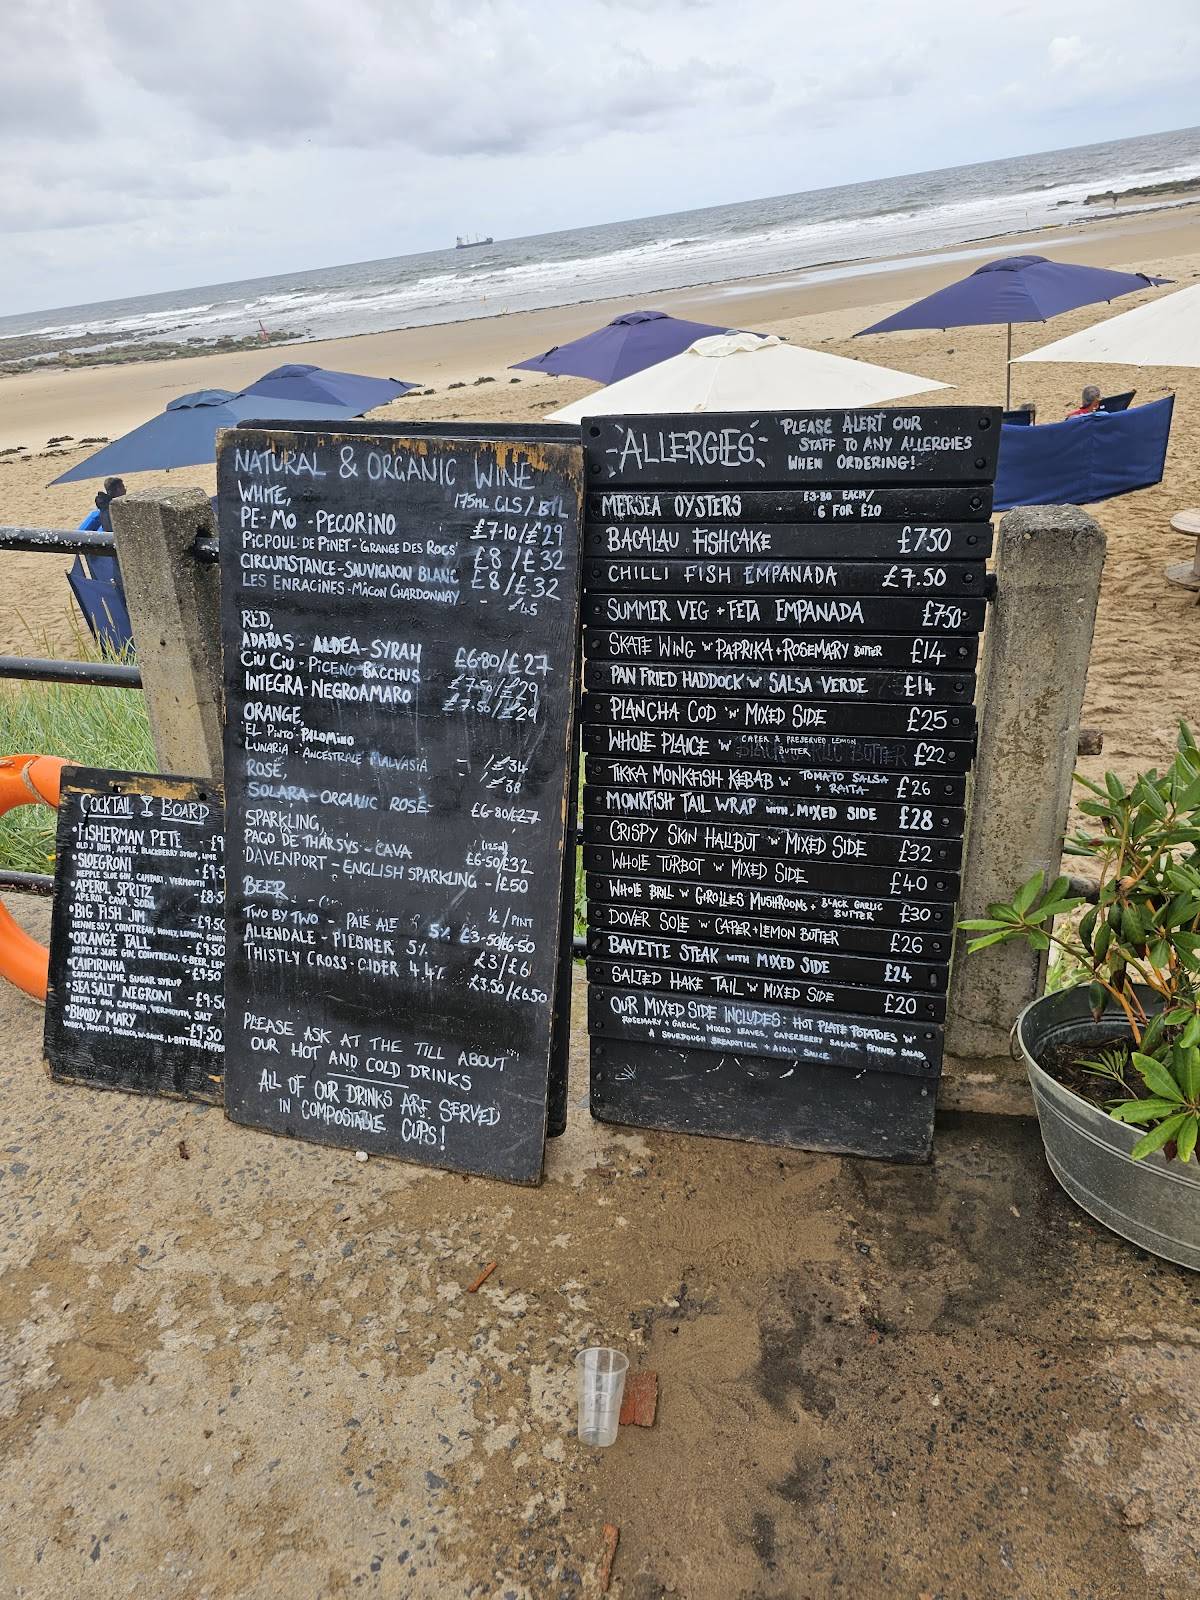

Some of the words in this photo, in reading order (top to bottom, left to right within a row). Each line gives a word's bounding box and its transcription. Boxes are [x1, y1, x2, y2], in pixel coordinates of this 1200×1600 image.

[781, 417, 832, 435] PLEASE
[842, 414, 887, 434] ALERT
[892, 415, 922, 432] OUR
[620, 428, 755, 473] ALLERGIES
[799, 437, 837, 452] STAFF
[842, 436, 859, 451] TO
[862, 436, 893, 451] ANY
[901, 435, 972, 452] ALLERGIES
[235, 448, 326, 476] NATURAL
[339, 446, 358, 479] &
[368, 453, 457, 486] ORGANIC
[474, 451, 535, 490] WINE
[788, 455, 823, 471] WHEN
[837, 455, 916, 471] ORDERING!
[238, 480, 291, 506] WHITE,
[674, 495, 742, 517] OYSTERS
[833, 504, 855, 517] FOR
[302, 537, 315, 550] DE
[403, 540, 423, 554] DES
[606, 526, 679, 553] BACALAU
[418, 566, 460, 583] BLANC
[608, 566, 669, 582] CHILLI
[684, 566, 731, 584] FISH
[744, 567, 837, 587] EMPANADA
[243, 573, 266, 588] LES
[274, 575, 344, 595] ENRACINES
[390, 583, 460, 605] CHARDONNAY
[242, 609, 274, 629] RED,
[607, 600, 671, 621] SUMMER
[678, 600, 708, 621] VEG
[775, 600, 865, 625] EMPANADA
[609, 632, 651, 656] SKATE
[240, 651, 266, 667] CIU
[270, 654, 295, 671] CIU
[610, 666, 636, 687] PAN
[640, 667, 677, 689] FRIED
[682, 669, 744, 691] HADDOCK
[769, 673, 812, 694] SALSA
[821, 675, 868, 694] VERDE
[610, 696, 680, 722] PLANCHA
[745, 702, 785, 727] MIXED
[792, 704, 827, 729] SIDE
[907, 707, 948, 732] £25
[245, 737, 289, 756] LUNARIA
[370, 751, 428, 773] MALVASIA
[609, 726, 656, 754] WHOLE
[914, 742, 946, 766] £22
[652, 765, 723, 789] MONKFISH
[728, 769, 773, 791] KEBAB
[799, 769, 844, 782] TOMATO
[80, 794, 134, 815] COCKTAIL
[161, 798, 209, 820] BOARD
[321, 790, 378, 810] ORGANIC
[680, 792, 711, 814] TAIL
[716, 796, 756, 816] WRAP
[847, 806, 877, 821] SIDE
[899, 806, 933, 830] £28
[150, 829, 182, 848] PETE
[244, 829, 275, 845] PAGO
[282, 833, 298, 848] DE
[376, 843, 412, 859] CAVA
[610, 819, 658, 844] CRISPY
[668, 824, 696, 846] SKIN
[785, 832, 826, 855] MIXED
[832, 835, 867, 858] SIDE
[899, 840, 933, 863] £32
[76, 870, 102, 879] HEPPLE
[169, 877, 205, 887] VERMOUTH
[244, 848, 328, 871] DAVENPORT
[343, 860, 404, 880] ENGLISH
[408, 866, 477, 889] SPARKLING
[611, 850, 651, 872] WHOLE
[657, 855, 705, 875] TURBOT
[731, 859, 768, 881] MIXED
[775, 862, 809, 883] SIDE
[890, 871, 928, 894] £40
[117, 882, 152, 898] SPRITZ
[243, 875, 288, 900] BEER
[133, 899, 156, 909] SODA
[609, 879, 642, 898] WHOLE
[649, 884, 674, 900] BRILL
[900, 903, 931, 922] £30
[99, 906, 122, 920] FISH
[128, 909, 145, 923] JIM
[243, 904, 268, 919] TWO
[272, 908, 288, 922] BY
[291, 910, 319, 924] TWO
[347, 912, 371, 929] PALE
[376, 917, 399, 933] ALE
[125, 934, 151, 949] FALL
[244, 923, 315, 944] ALLENDALE
[608, 907, 651, 929] DOVER
[659, 911, 690, 932] SOLE
[800, 924, 839, 945] BUTTER
[890, 932, 923, 954] £26
[244, 942, 300, 965] THISTLY
[608, 935, 671, 959] BAVETTE
[679, 944, 719, 965] STEAK
[800, 956, 831, 974] SIDE
[884, 963, 912, 983] £24
[122, 985, 172, 1002] NEGRONI
[158, 978, 182, 987] SYRUP
[611, 966, 662, 986] SALTED
[670, 973, 703, 991] HAKE
[711, 976, 744, 996] TAIL
[763, 982, 800, 1000] MIXED
[807, 989, 835, 1003] SIDE
[884, 993, 917, 1014] £20
[106, 1011, 136, 1027] MARY
[194, 1010, 212, 1021] SALT
[610, 996, 638, 1014] OUR
[644, 996, 685, 1018] MIXED
[688, 999, 717, 1021] SIDE
[792, 1016, 813, 1030] HOT
[817, 1019, 847, 1036] PLATE
[848, 1022, 897, 1044] POTATOES
[622, 1015, 662, 1026] ROSEMARY
[706, 1025, 731, 1034] MIXED
[243, 1012, 294, 1035] PLEASE
[304, 1026, 332, 1044] ASK
[340, 1033, 361, 1048] AT
[370, 1037, 402, 1053] THE
[414, 1042, 445, 1060] TILL
[458, 1051, 506, 1071] ABOUT
[662, 1030, 706, 1043] SOURDOUGH
[711, 1036, 757, 1049] BREADSTICK
[251, 1038, 280, 1053] OUR
[291, 1043, 321, 1060] HOT
[329, 1050, 357, 1068] AND
[366, 1058, 400, 1078] COLD
[407, 1063, 472, 1091] DRINKS
[259, 1069, 281, 1093] ALL
[289, 1075, 306, 1096] OF
[315, 1080, 340, 1102] OUR
[347, 1083, 392, 1107] DRINKS
[400, 1093, 429, 1117] ARE
[439, 1099, 500, 1126] SERVED
[280, 1098, 291, 1113] IN
[302, 1100, 386, 1133] COMPOSTABLE
[402, 1120, 445, 1150] CUPS!
